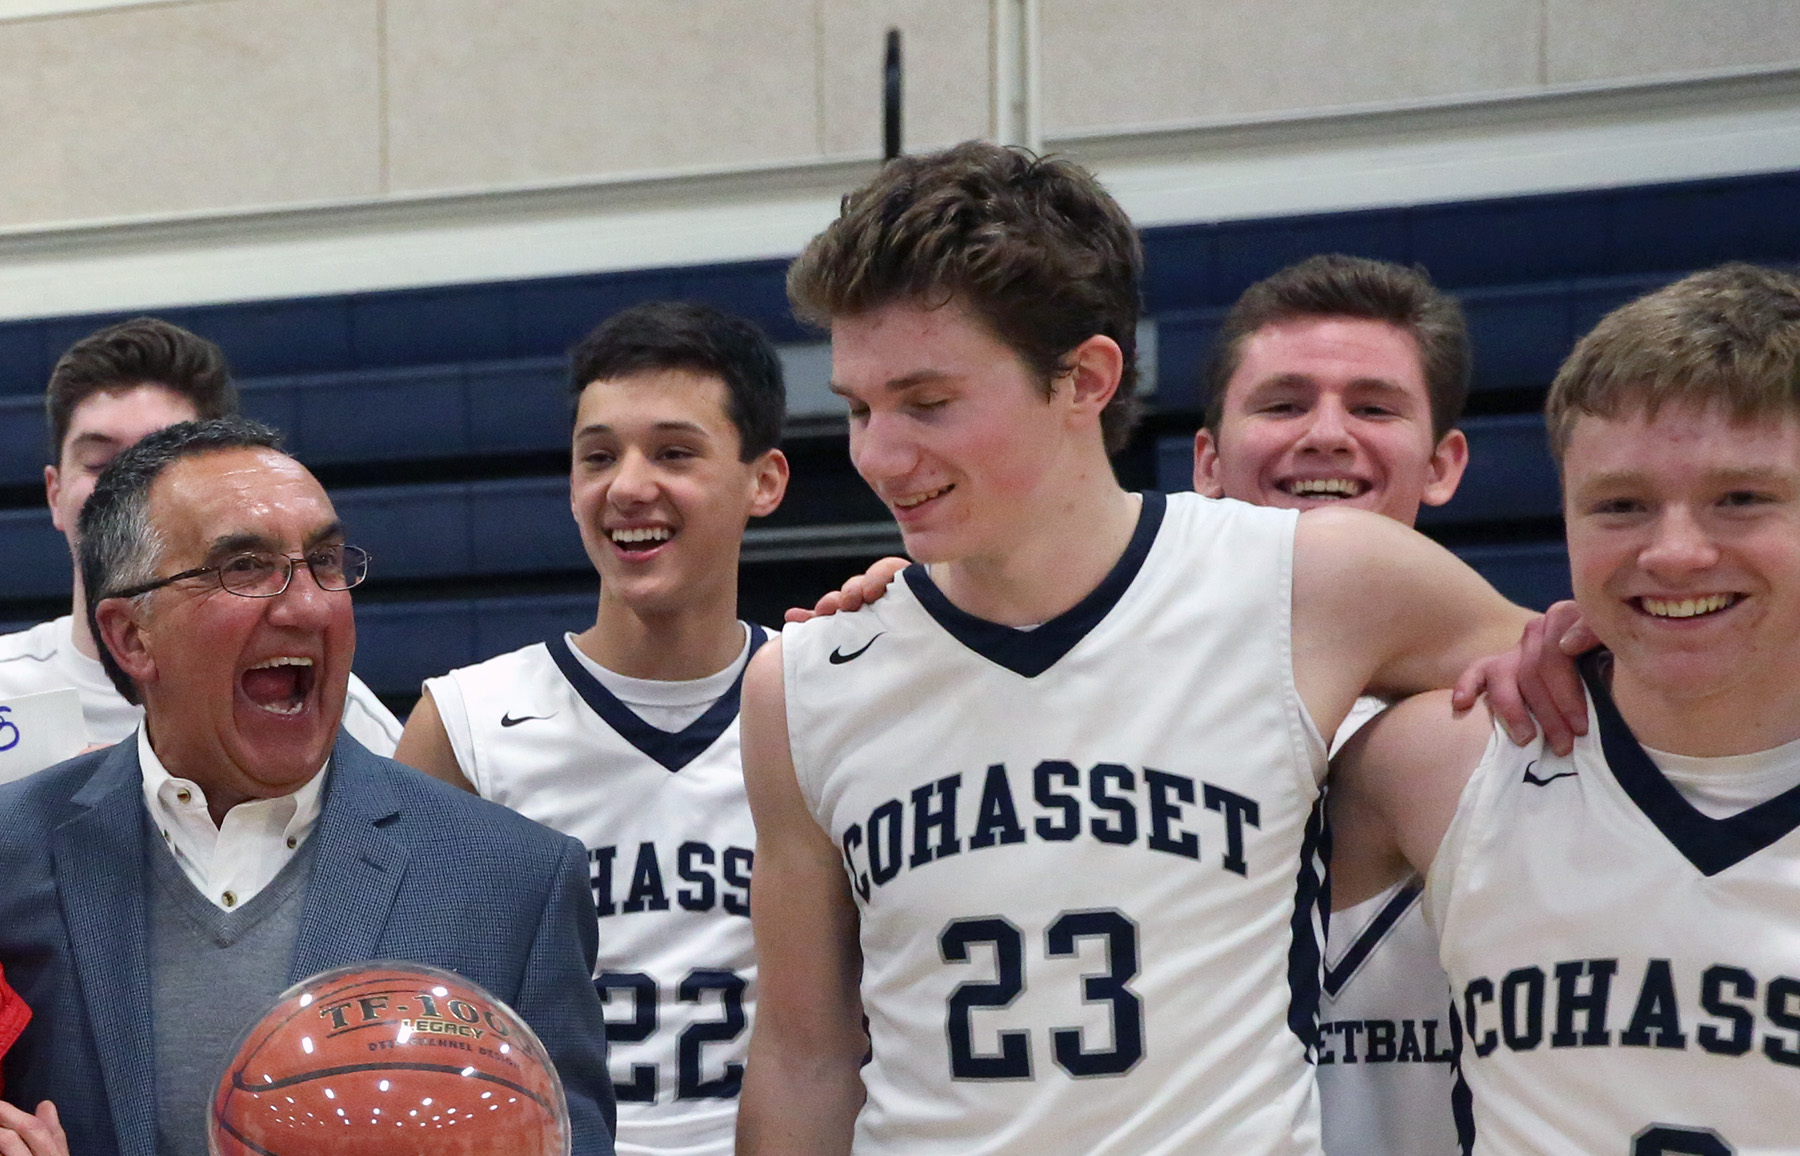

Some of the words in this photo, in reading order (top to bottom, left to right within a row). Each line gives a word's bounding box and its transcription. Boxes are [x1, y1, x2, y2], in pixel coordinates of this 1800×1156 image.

[841, 759, 1261, 906] COHASSET
[401, 1018, 484, 1040] LEGACY
[593, 967, 749, 1106] 22
[937, 907, 1146, 1083] 23
